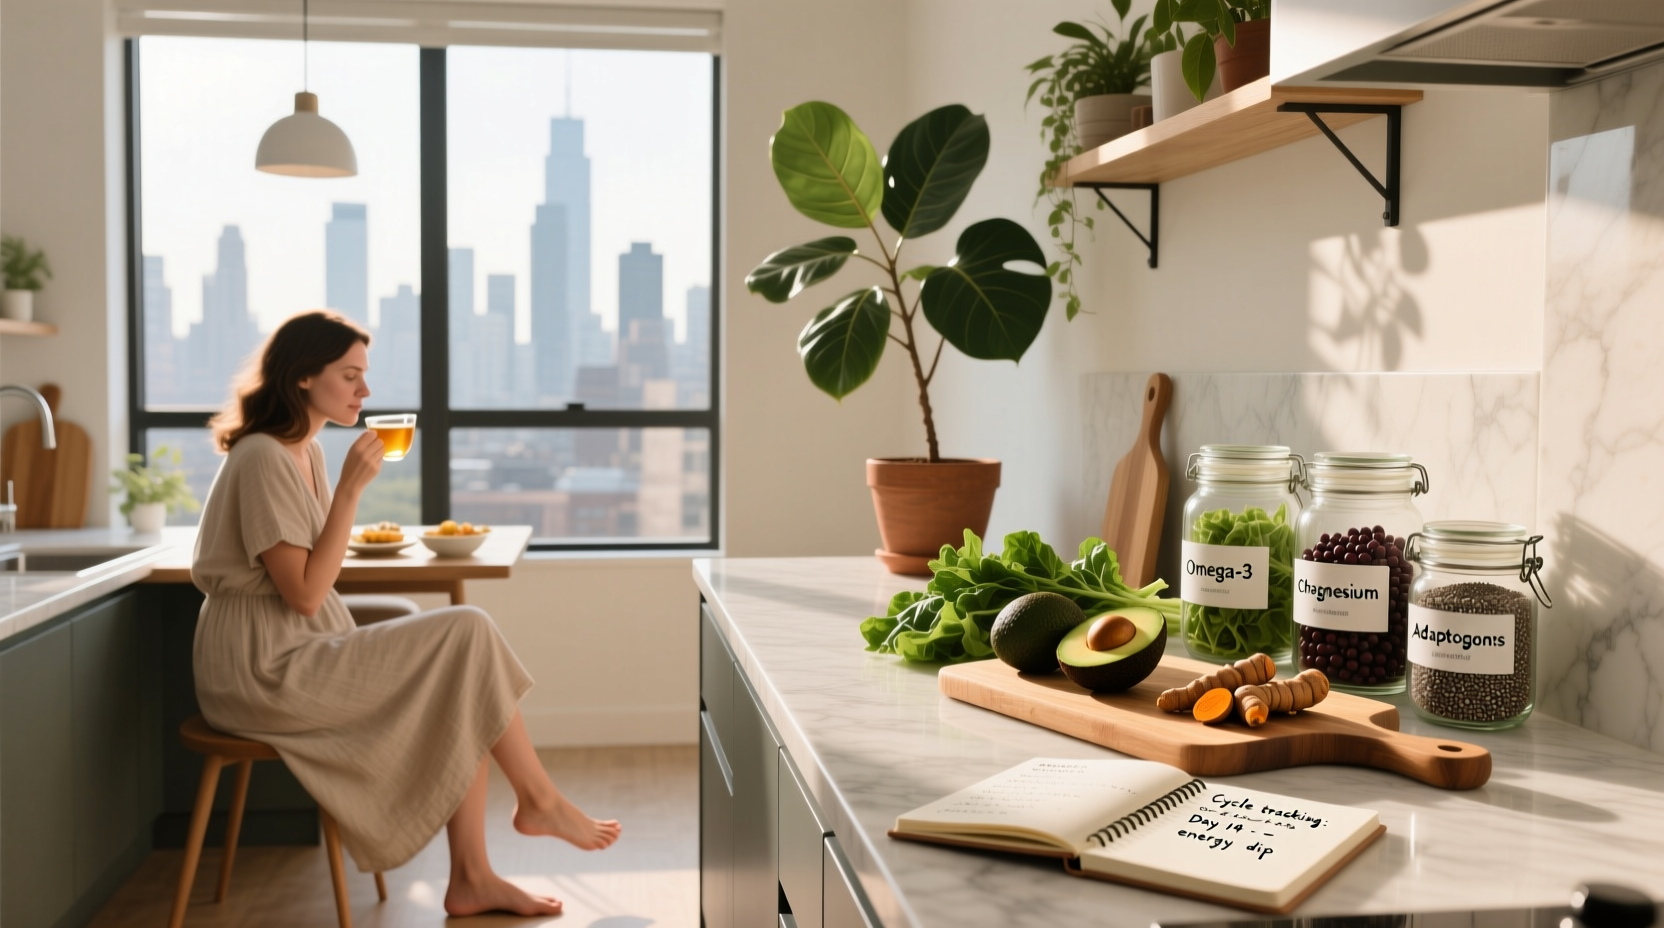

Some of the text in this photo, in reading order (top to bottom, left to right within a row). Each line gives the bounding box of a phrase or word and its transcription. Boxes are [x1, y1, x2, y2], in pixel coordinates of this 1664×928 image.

[1186, 559, 1253, 583] Omega-3
[1212, 794, 1254, 810] Cycle
[1188, 814, 1219, 831] Day
[1177, 829, 1274, 860] energy dip
